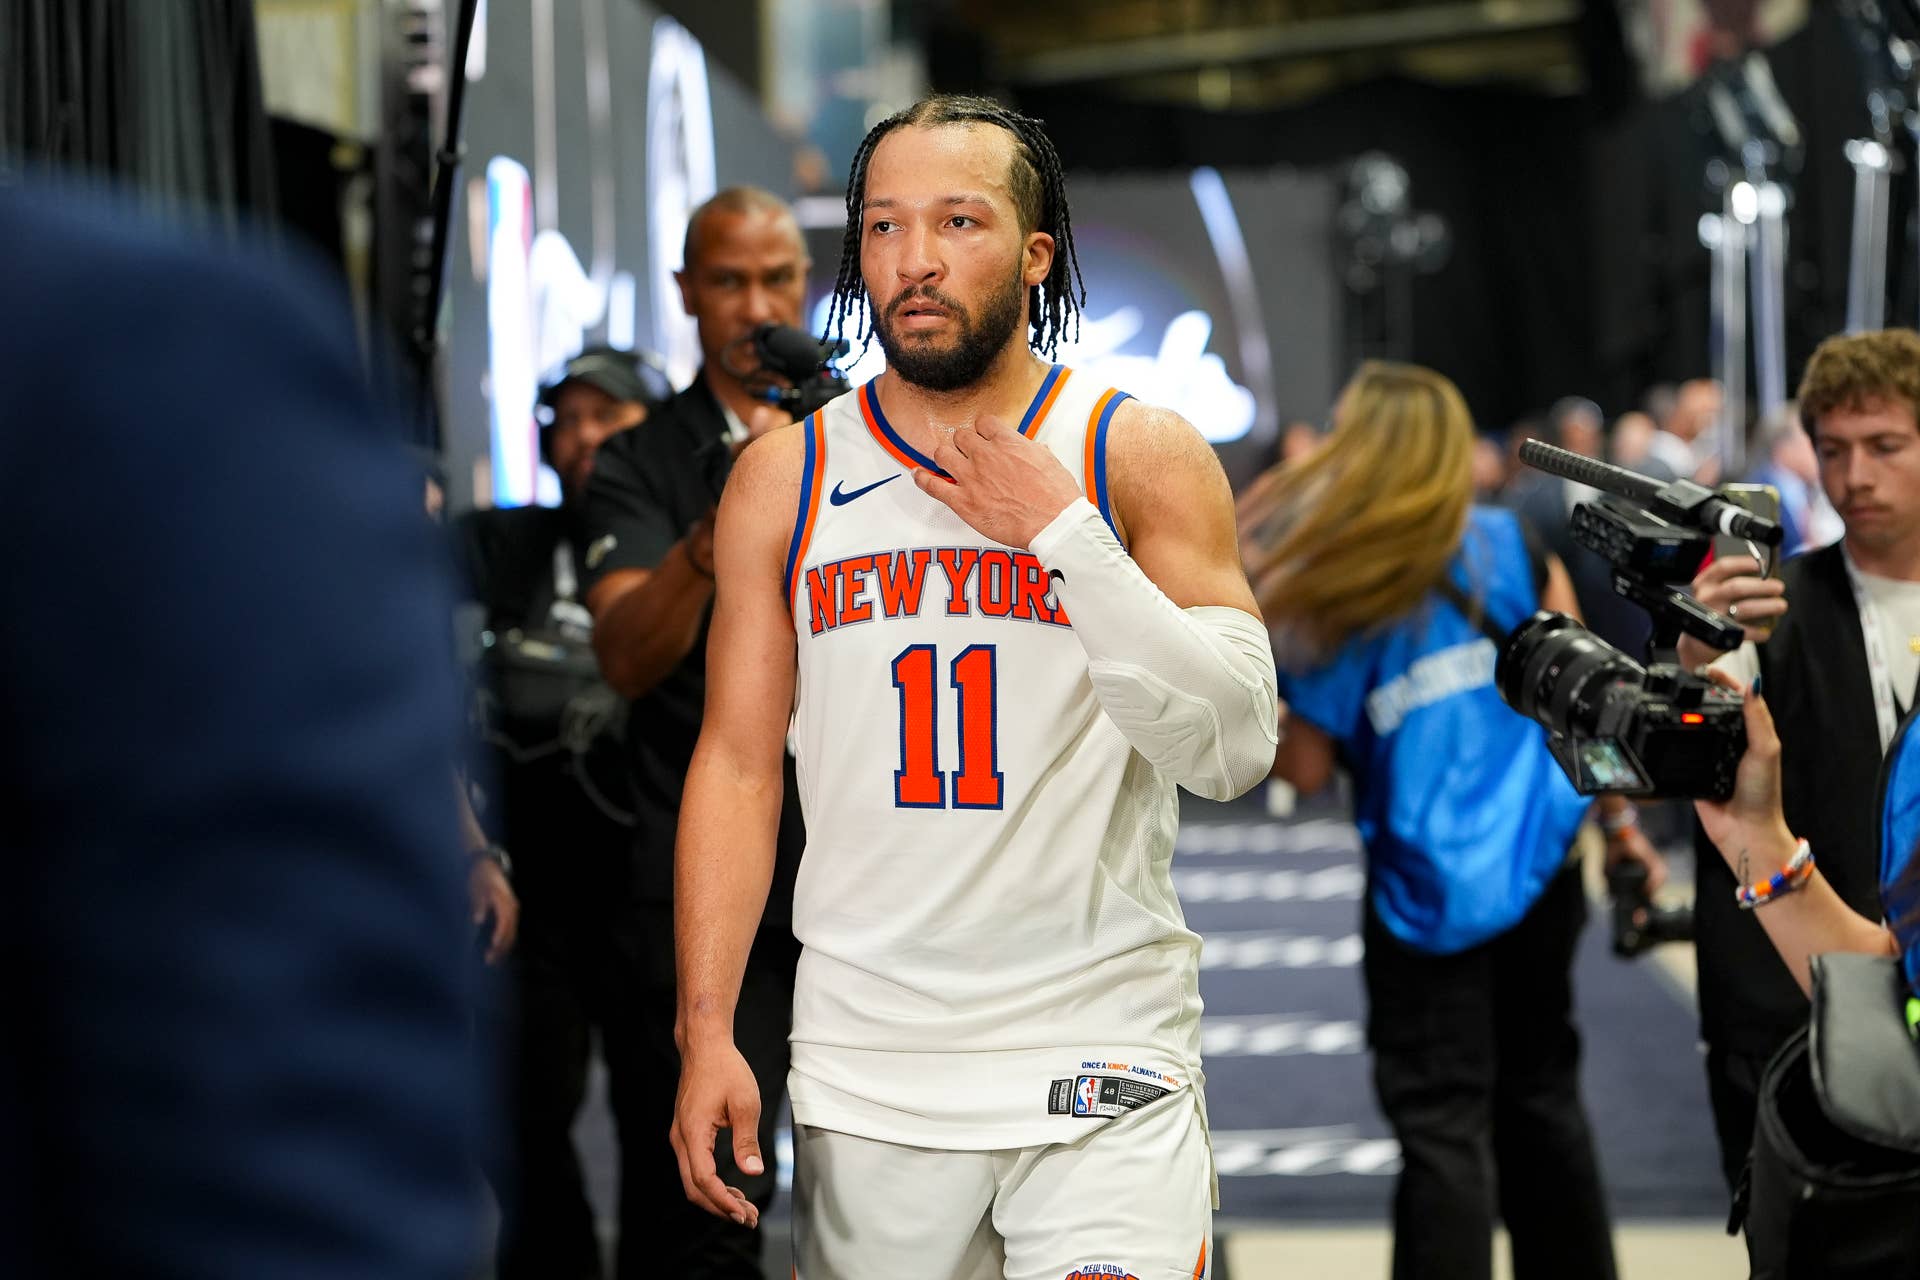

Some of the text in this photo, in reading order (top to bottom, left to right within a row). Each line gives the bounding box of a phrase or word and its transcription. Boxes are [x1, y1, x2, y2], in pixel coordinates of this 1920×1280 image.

[805, 546, 1072, 637] NEW YOR
[891, 644, 1004, 810] 11
[1107, 1062, 1131, 1073] KNICK,
[1131, 1066, 1157, 1079] ALWAYS
[1104, 1087, 1115, 1095] 48
[1083, 1264, 1101, 1273] NEW
[1102, 1264, 1124, 1275] YORK
